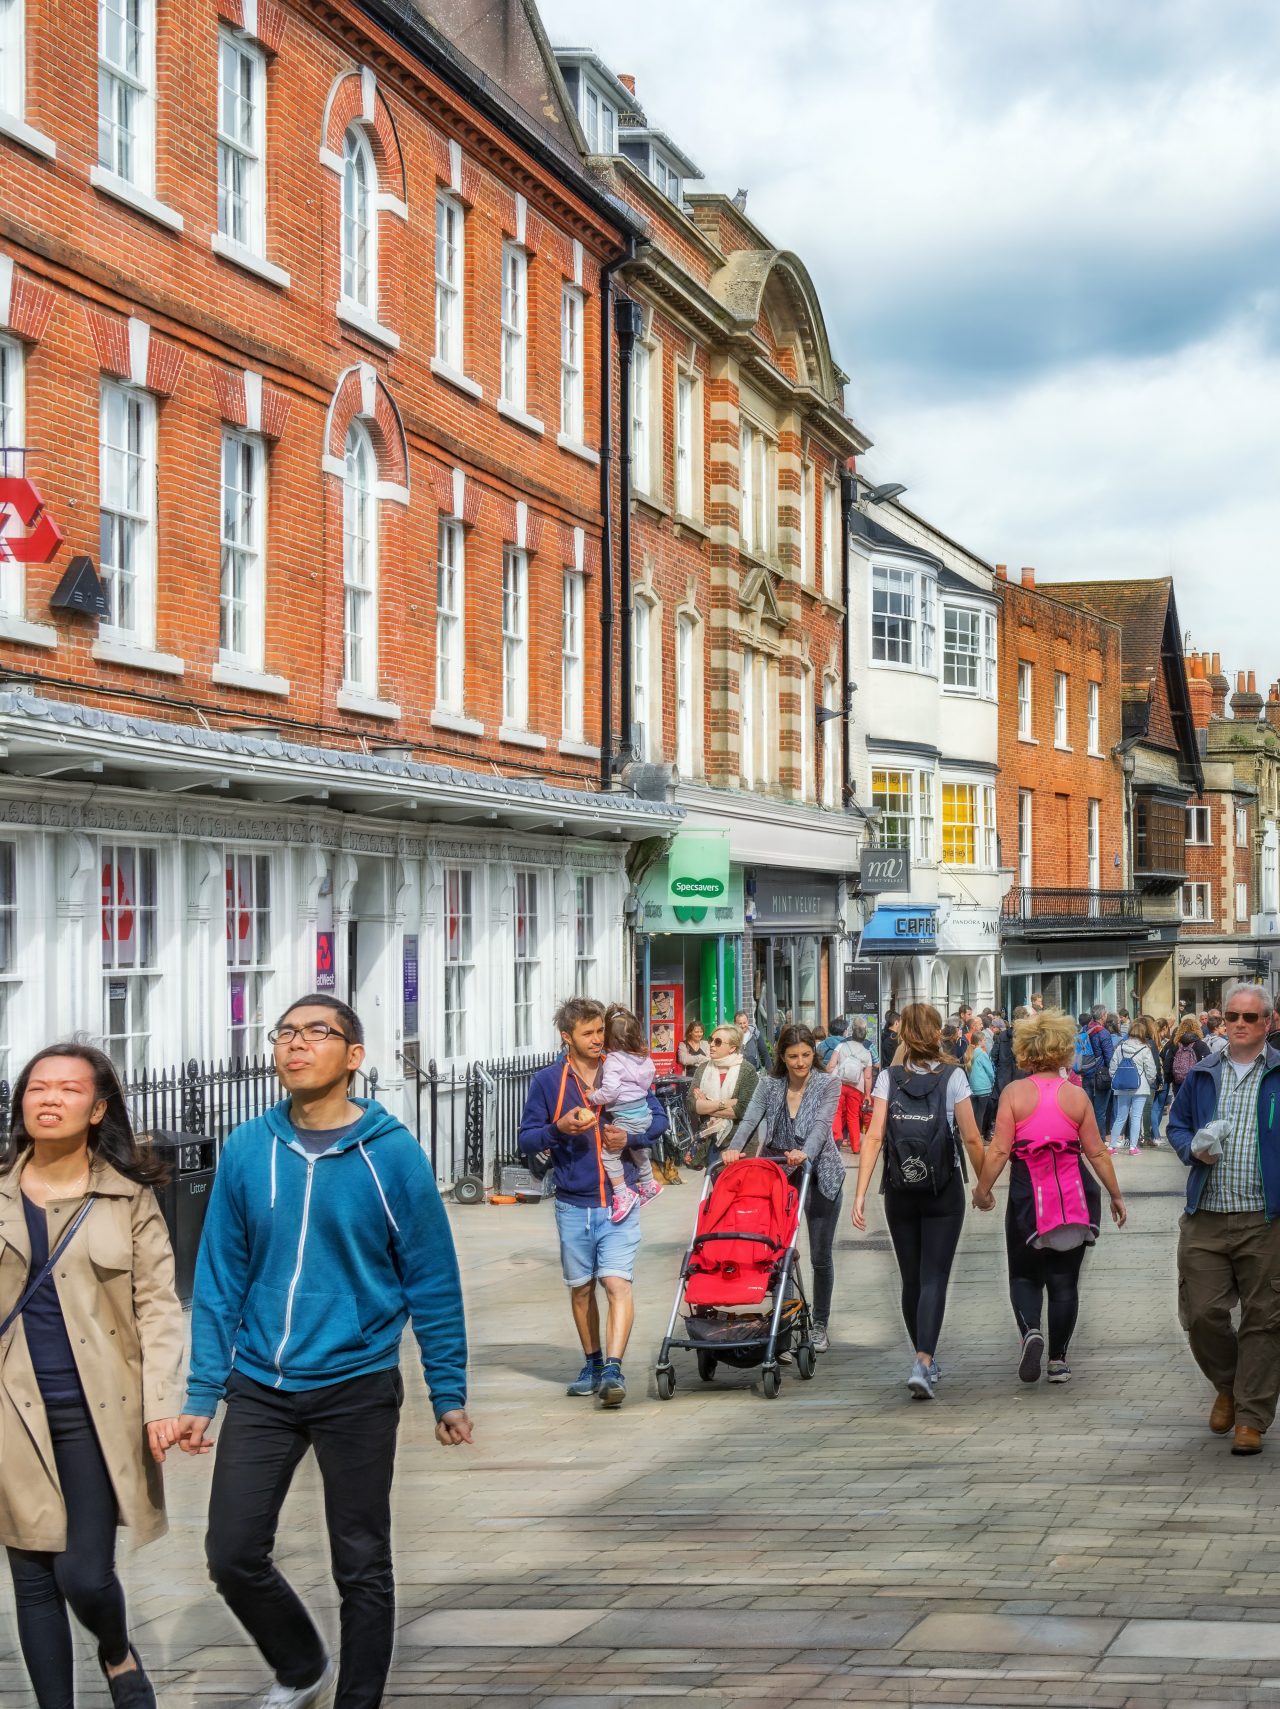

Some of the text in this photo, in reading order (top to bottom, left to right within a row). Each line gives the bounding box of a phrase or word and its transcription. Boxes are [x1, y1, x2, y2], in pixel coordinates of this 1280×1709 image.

[676, 882, 719, 892] Specsavers
[772, 895, 821, 913] MINT VELVET
[1194, 954, 1220, 970] Eight
[317, 974, 334, 985] atWest
[190, 1183, 207, 1194] Litter
